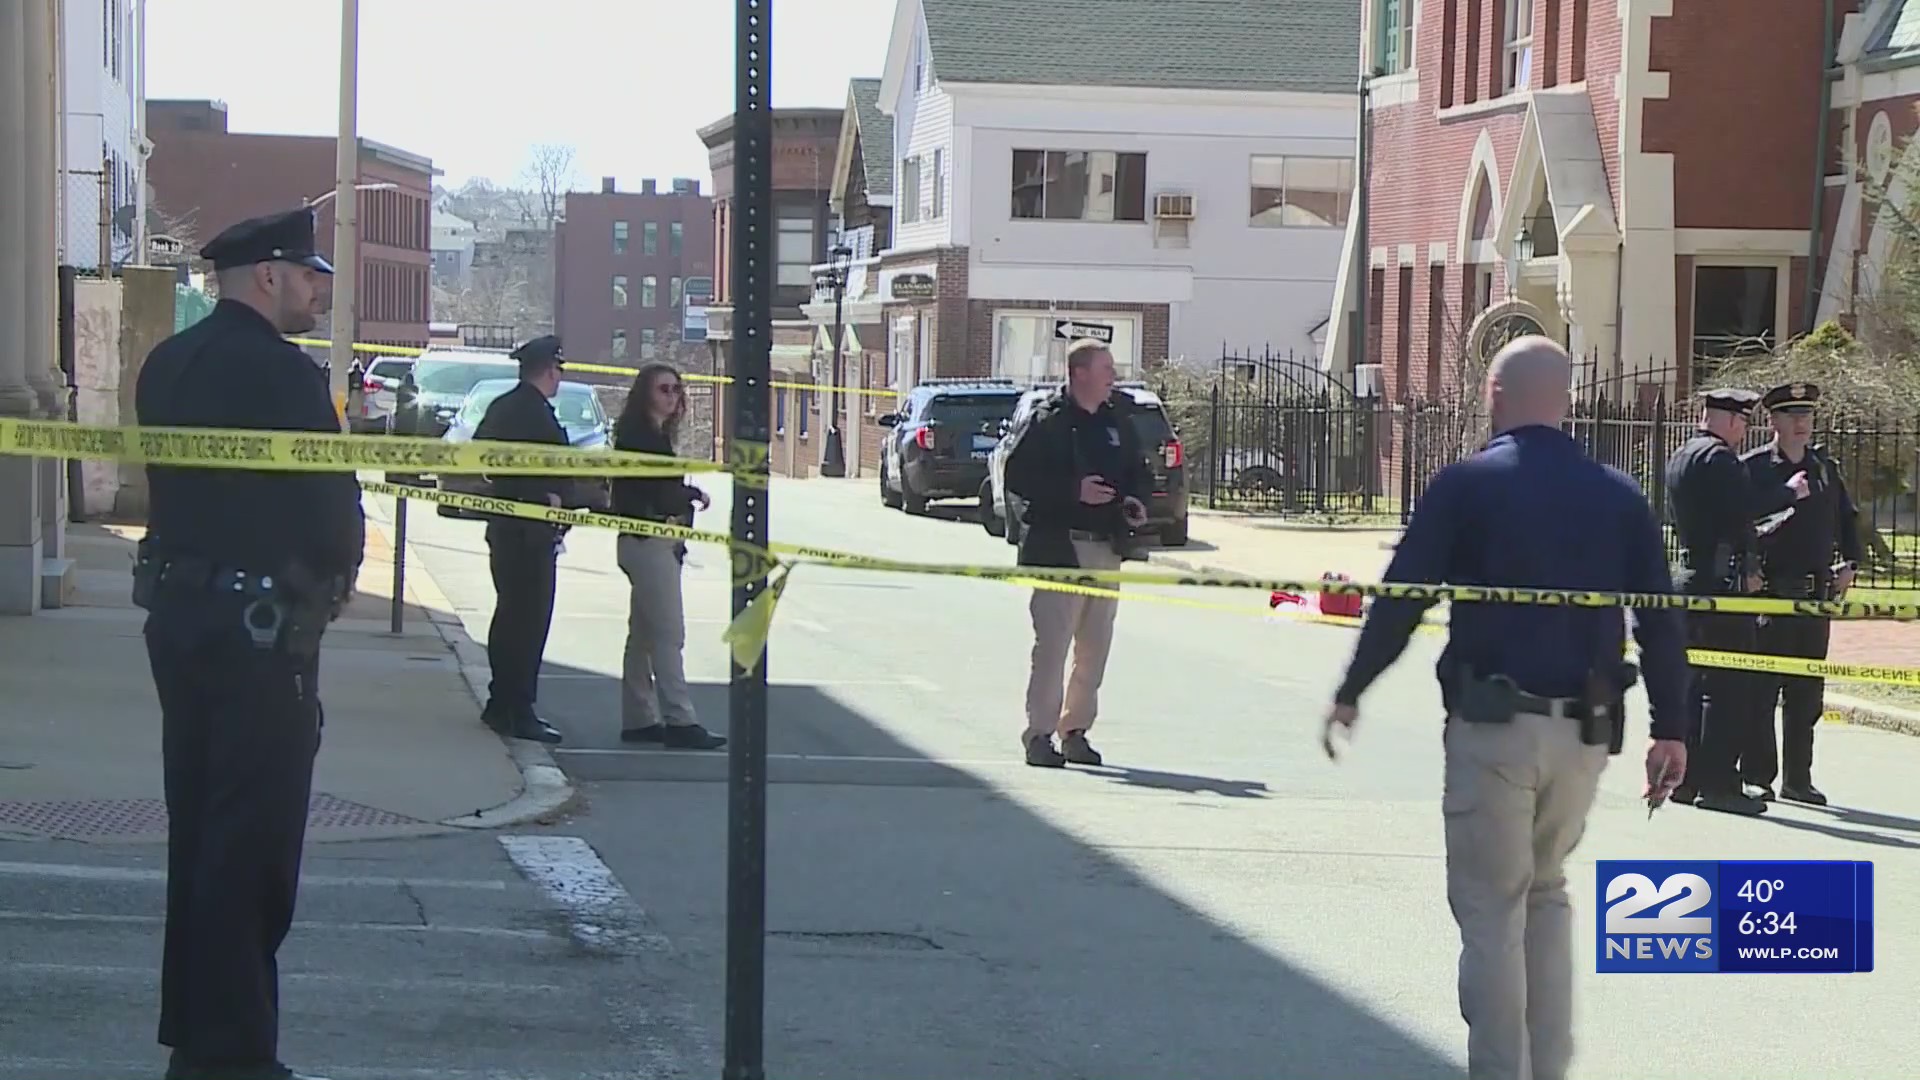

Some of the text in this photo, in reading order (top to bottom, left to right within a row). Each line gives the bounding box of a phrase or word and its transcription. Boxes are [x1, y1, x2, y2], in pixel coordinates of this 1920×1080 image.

[1072, 326, 1106, 337] ONE WAY
[363, 482, 396, 494] ENE
[460, 496, 515, 513] CROSS
[545, 509, 596, 525] CRIME
[598, 516, 649, 533] SCENE
